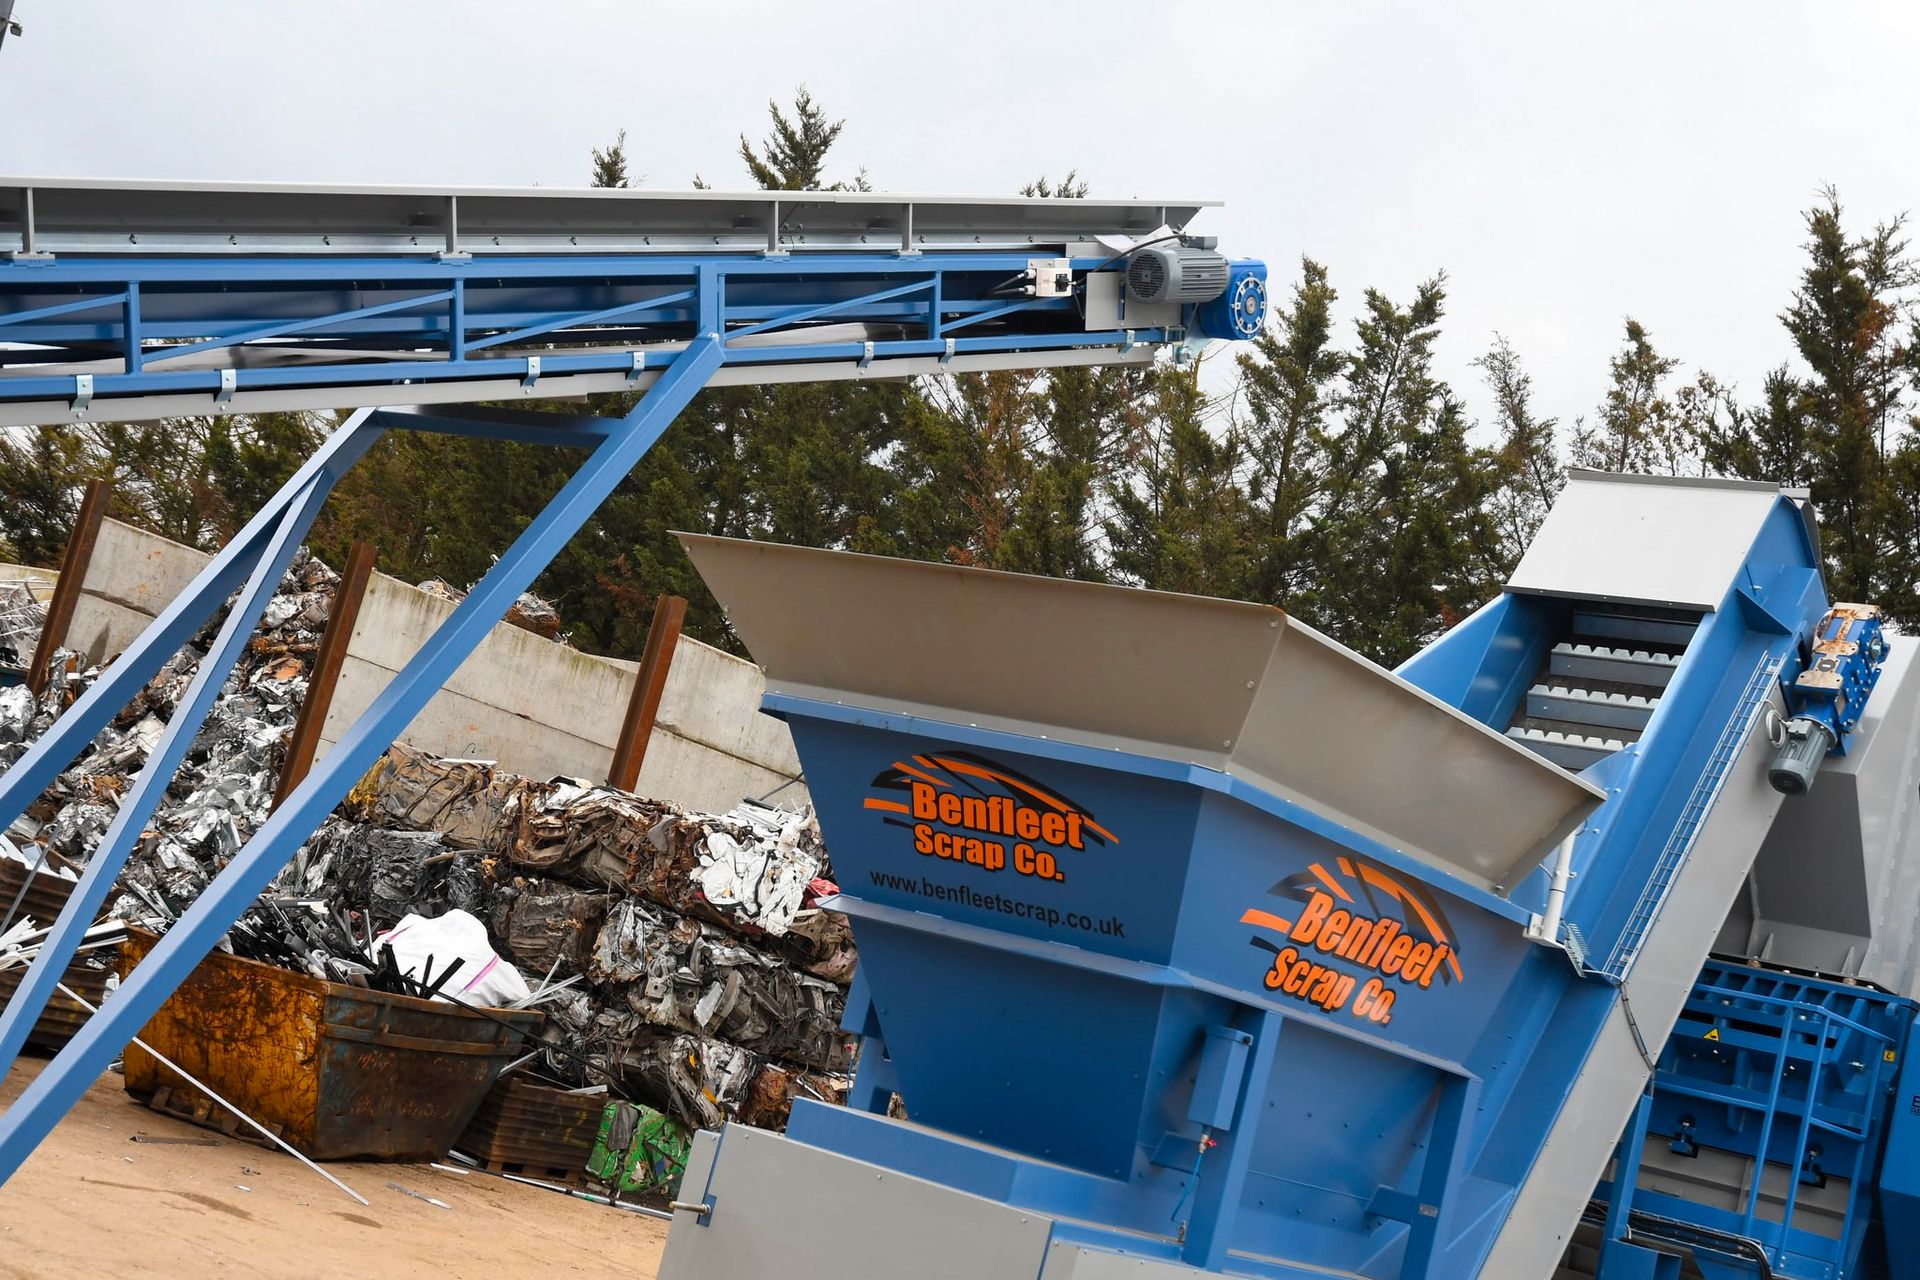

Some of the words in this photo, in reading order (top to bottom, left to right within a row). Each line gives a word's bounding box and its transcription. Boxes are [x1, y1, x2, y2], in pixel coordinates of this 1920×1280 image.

[912, 780, 1084, 850] Benfleet
[914, 824, 1006, 871] Scrap
[1013, 841, 1065, 881] Co.
[870, 870, 1125, 938] www.benfleetscrap.co.uk
[1289, 889, 1450, 988] Benfleet
[1264, 947, 1356, 1012] Scrap
[1352, 977, 1397, 1026] Co.
